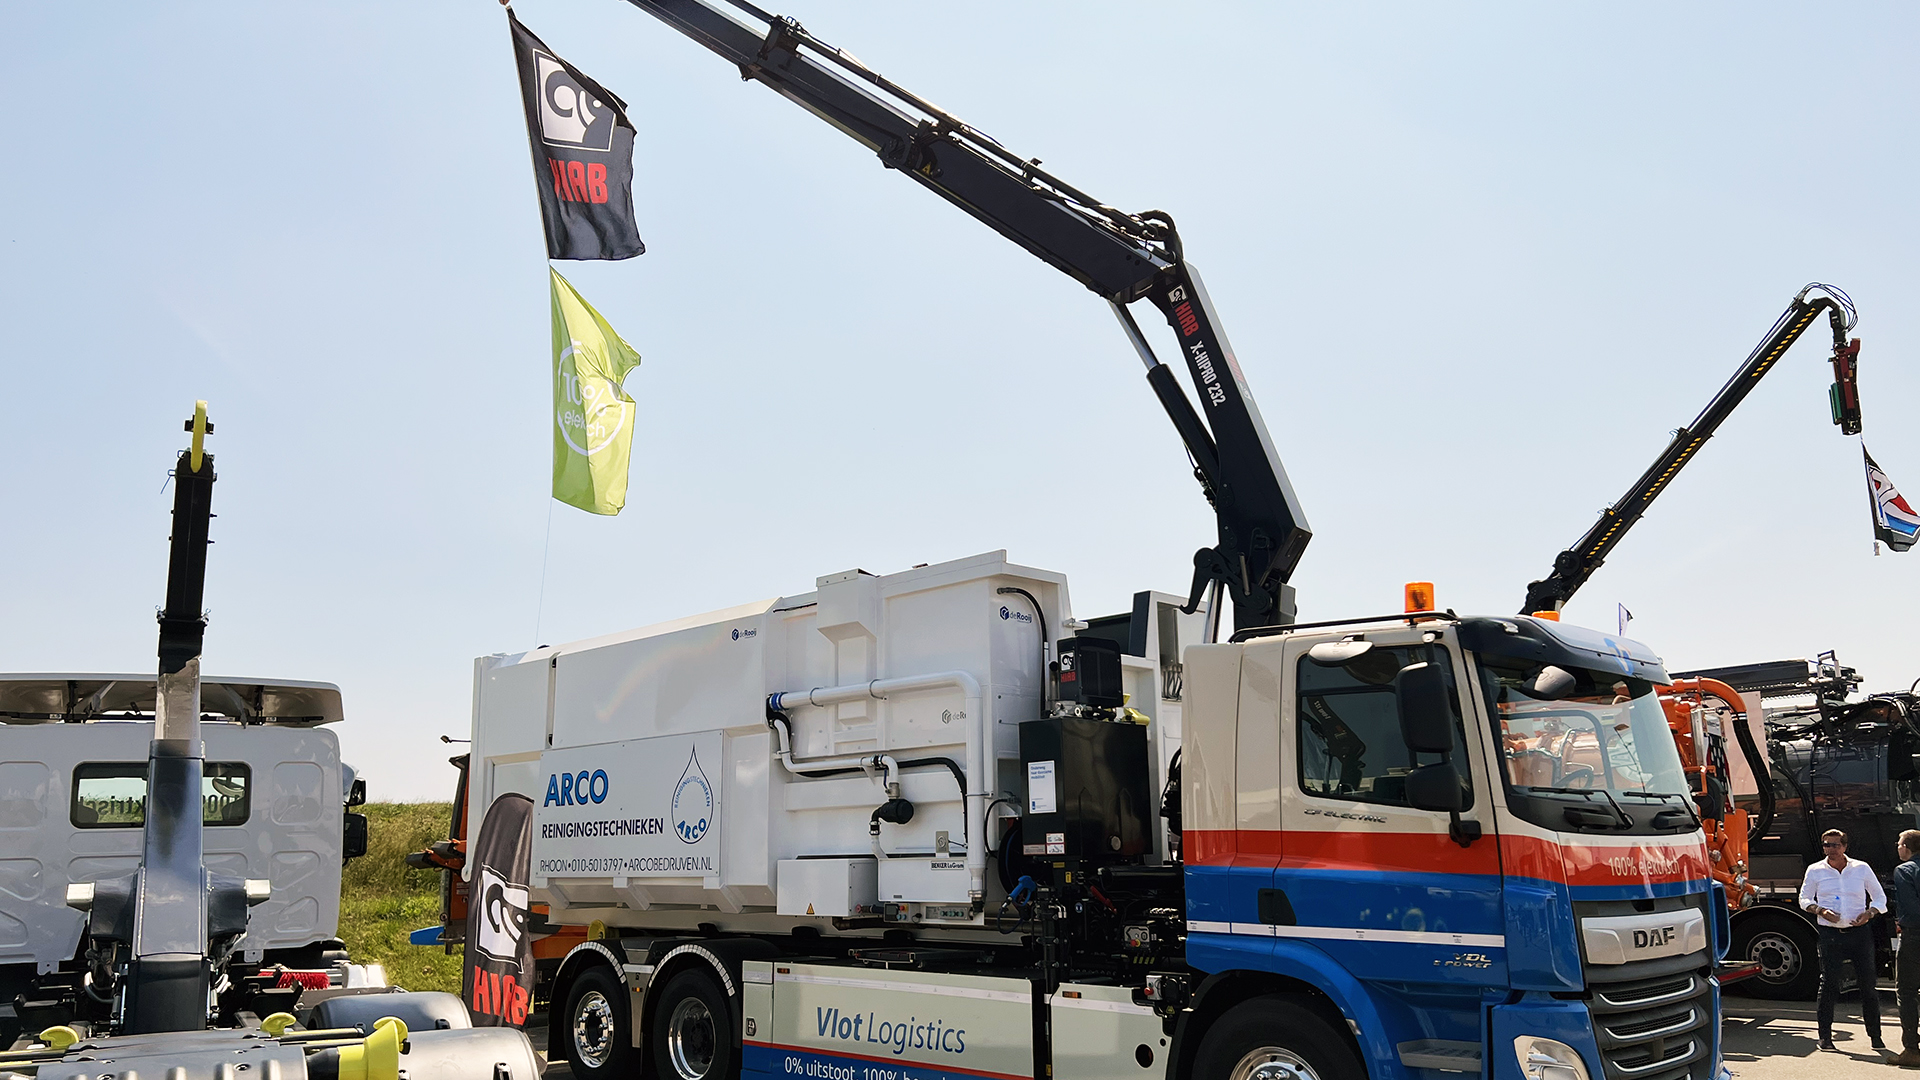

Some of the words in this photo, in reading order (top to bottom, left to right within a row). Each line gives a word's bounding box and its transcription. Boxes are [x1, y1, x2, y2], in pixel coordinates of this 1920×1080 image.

[1175, 301, 1199, 337] HIAB
[1189, 340, 1217, 385] X-HIPRO
[1207, 382, 1227, 407] 232
[1061, 671, 1076, 682] HIAB
[543, 768, 609, 807] ARCO
[1304, 808, 1322, 816] CF
[1324, 810, 1387, 823] ELECTRIC
[542, 818, 664, 839] REINIGINGSTECHNIEKEN
[677, 817, 707, 840] ARCO
[1608, 857, 1638, 877] 100%
[1638, 857, 1681, 876] elektrisch
[1633, 926, 1675, 948] DAF
[1453, 952, 1492, 963] VDL
[473, 965, 529, 1026] HIAB
[817, 1007, 863, 1041] Vlot
[867, 1012, 966, 1055] Logistics
[785, 1056, 803, 1075] 0%
